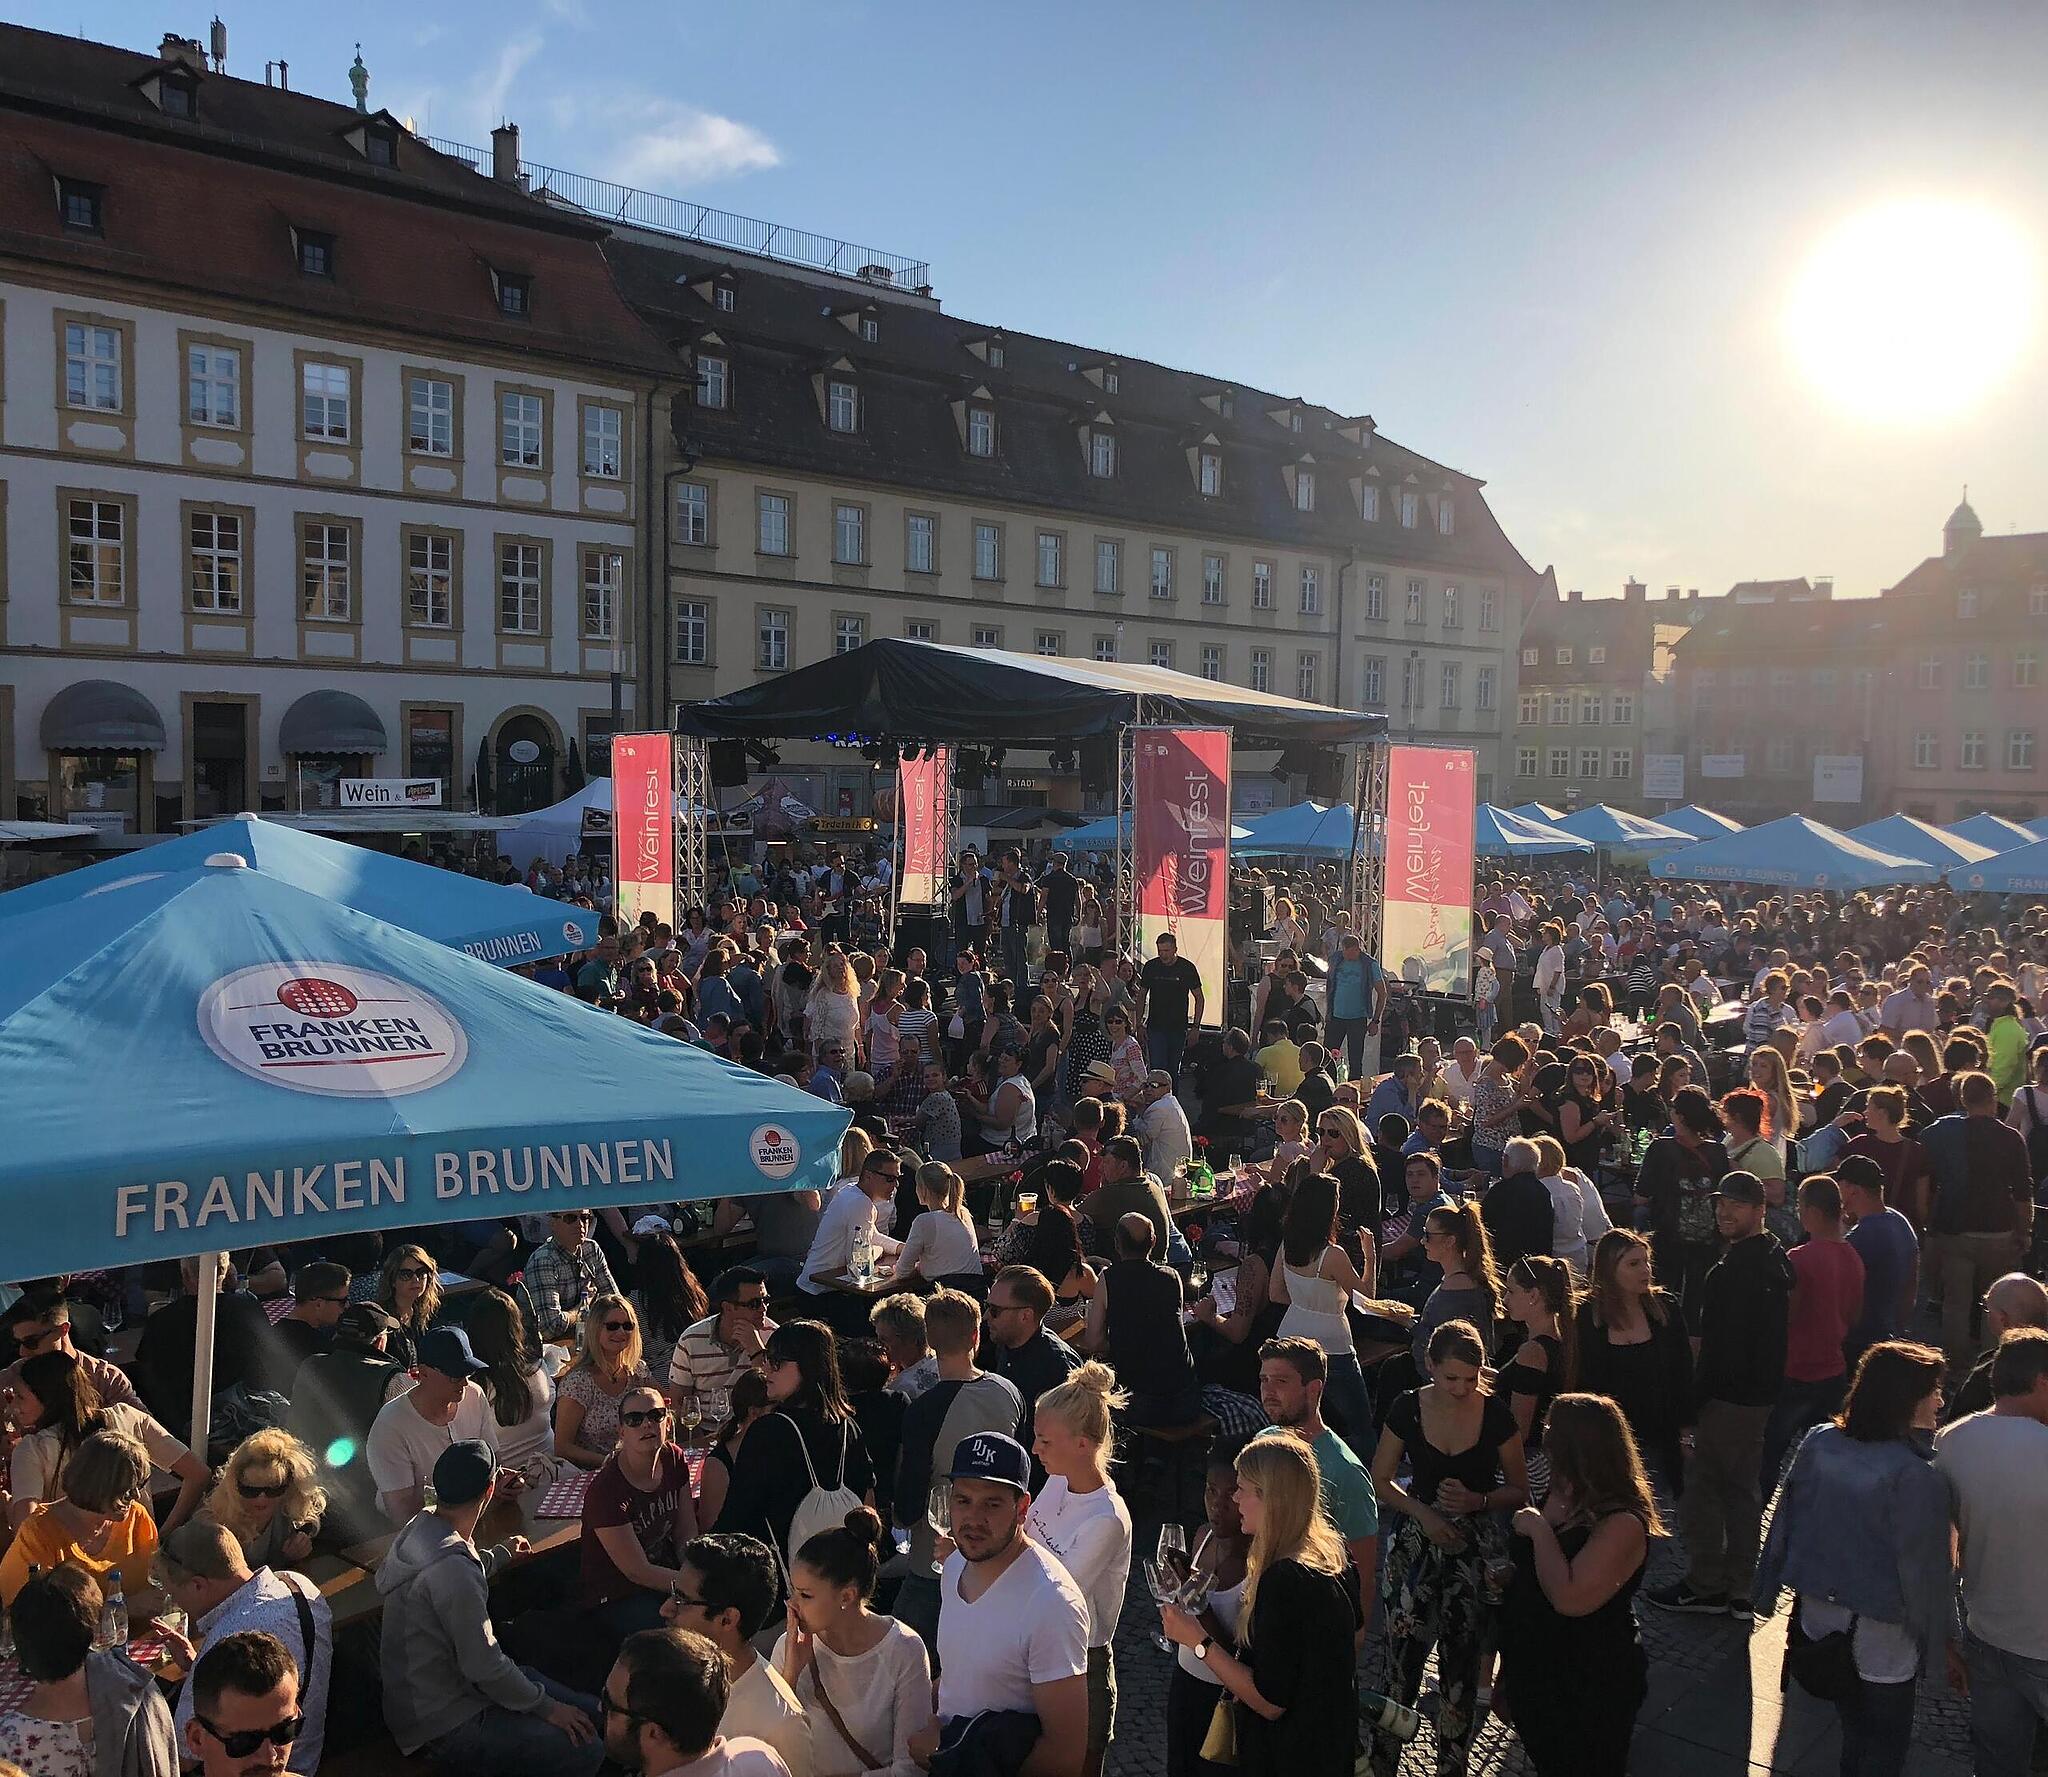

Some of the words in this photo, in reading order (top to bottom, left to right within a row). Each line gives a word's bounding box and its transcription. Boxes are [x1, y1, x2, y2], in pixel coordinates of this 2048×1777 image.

[345, 783, 390, 802] Wein
[642, 768, 660, 882] Weinfest
[1179, 771, 1209, 916] Weinfest
[1694, 865, 1741, 879] FRANKEN
[463, 930, 542, 962] BRUNNEN
[249, 1017, 423, 1042] FRANKEN
[259, 1034, 433, 1061] BRUNNEN
[758, 1147, 793, 1156] FRANKEN
[760, 1154, 794, 1163] BRUNNEN
[115, 1156, 406, 1238] FRANKEN
[434, 1138, 675, 1200] BRUNNEN
[972, 1439, 997, 1464] DJK
